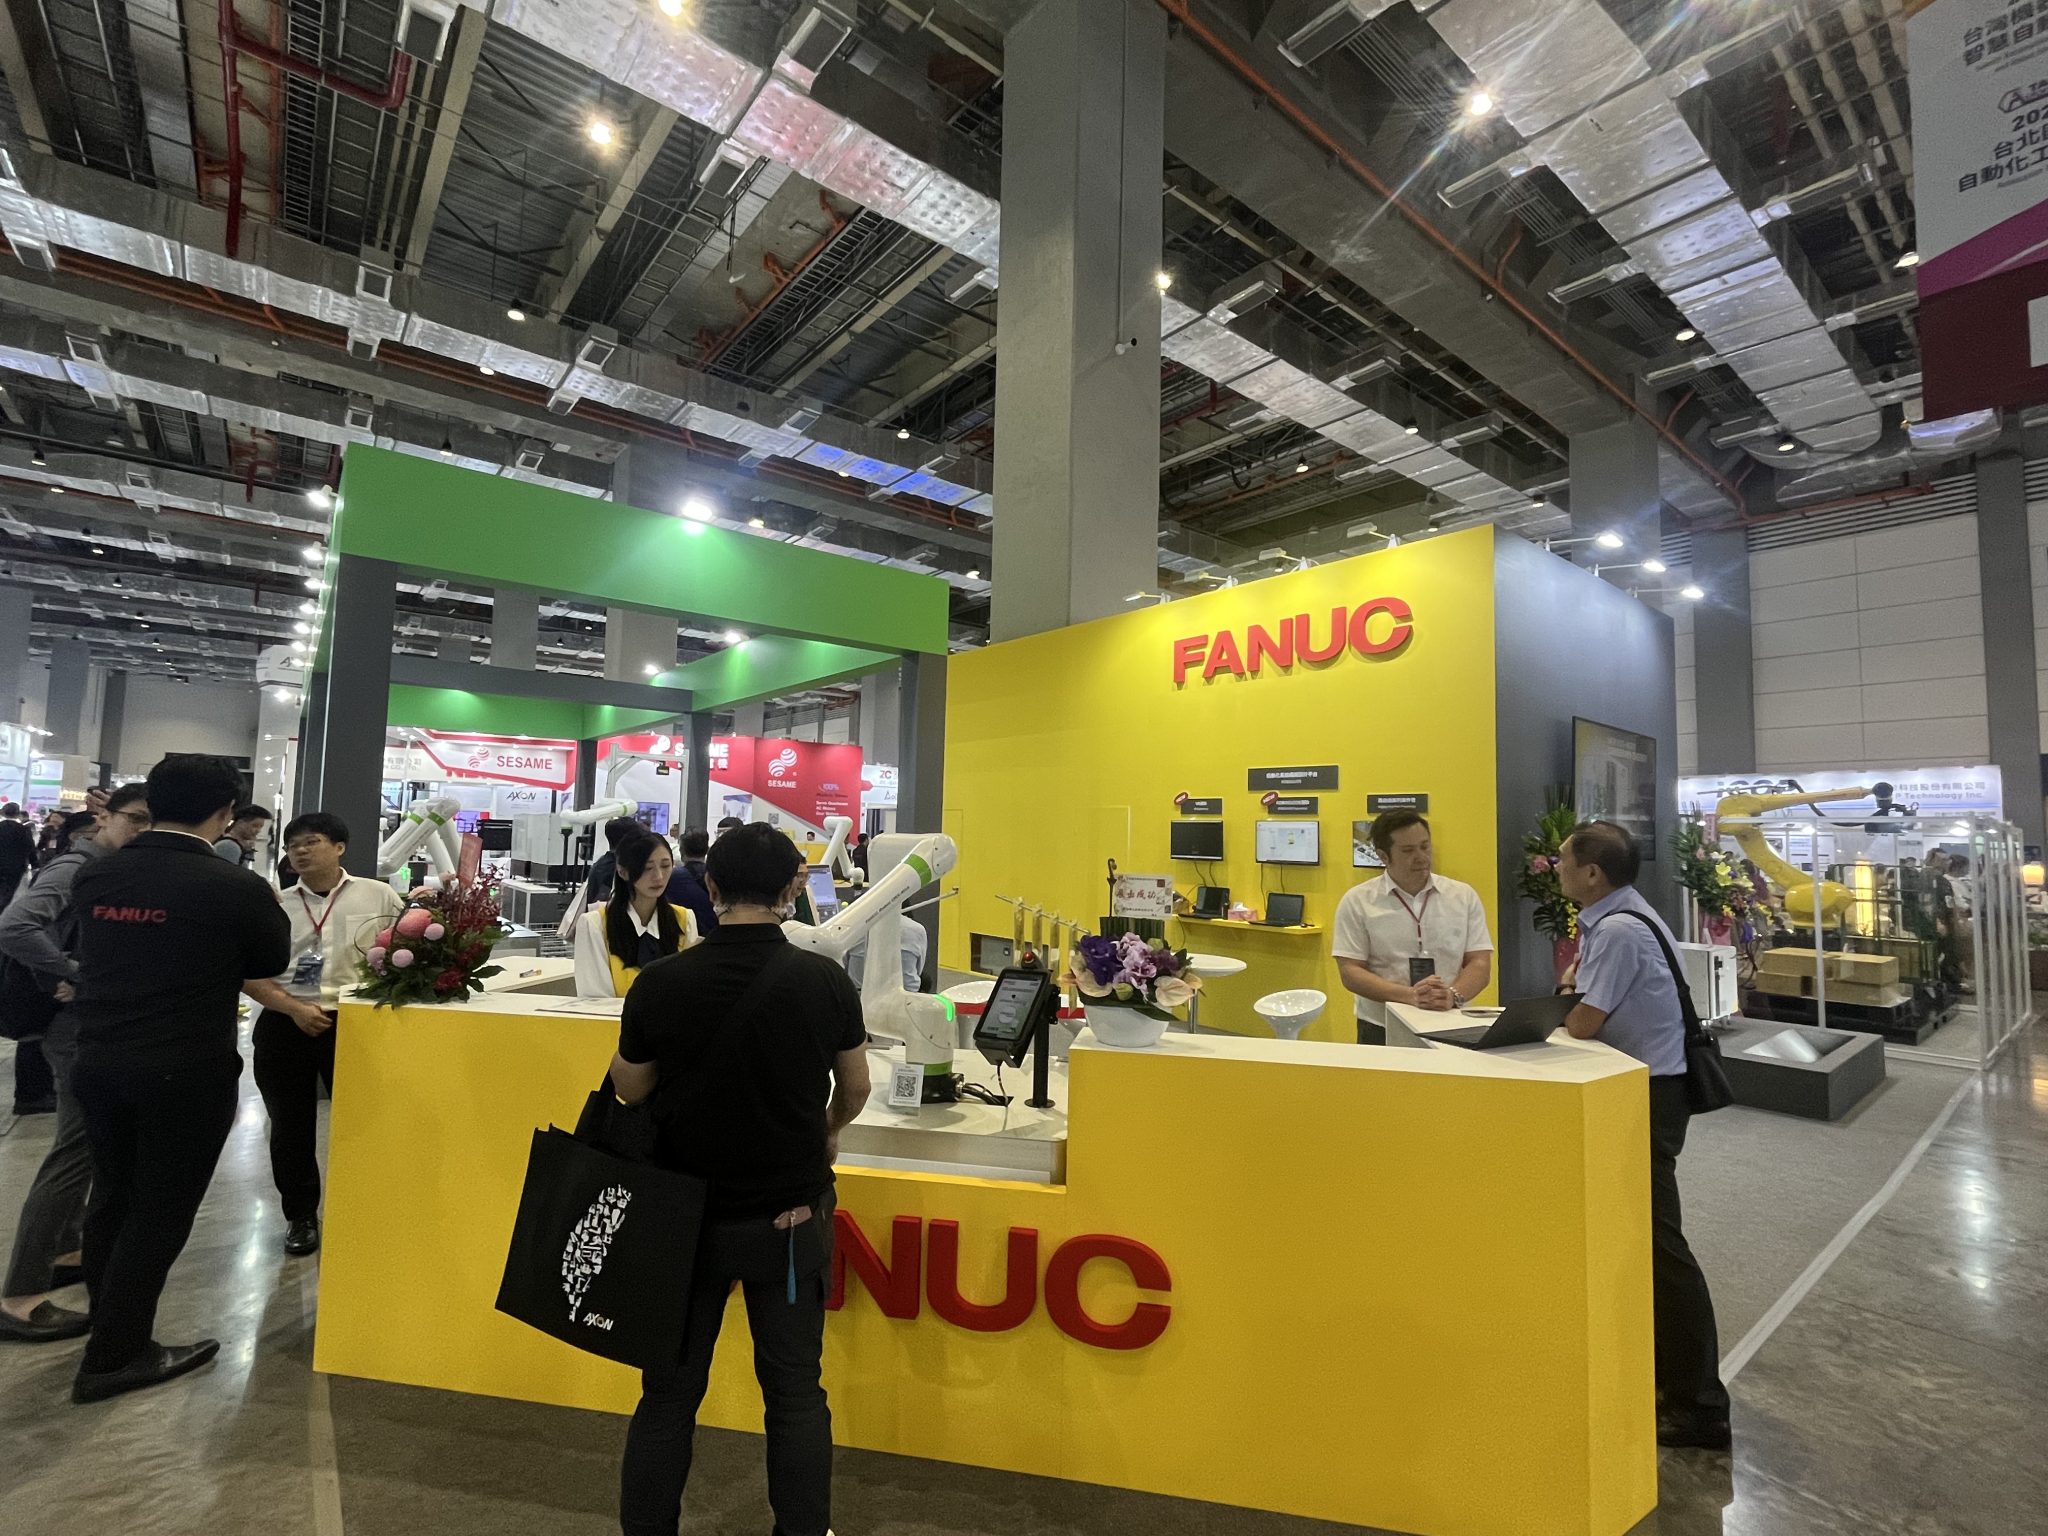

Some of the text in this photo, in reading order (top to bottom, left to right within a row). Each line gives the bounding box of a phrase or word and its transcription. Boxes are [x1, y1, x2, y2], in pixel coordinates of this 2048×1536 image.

[1994, 122, 2048, 161] 台北
[1958, 144, 2048, 193] 自動化工
[1173, 596, 1414, 688] FANUC
[496, 755, 553, 770] SESAME
[767, 780, 797, 789] SESAME
[506, 791, 537, 801] AXON
[1904, 791, 1963, 801] Technology
[92, 905, 168, 923] FANUC
[825, 1209, 1172, 1350] NUC
[582, 1312, 614, 1331] AXON
